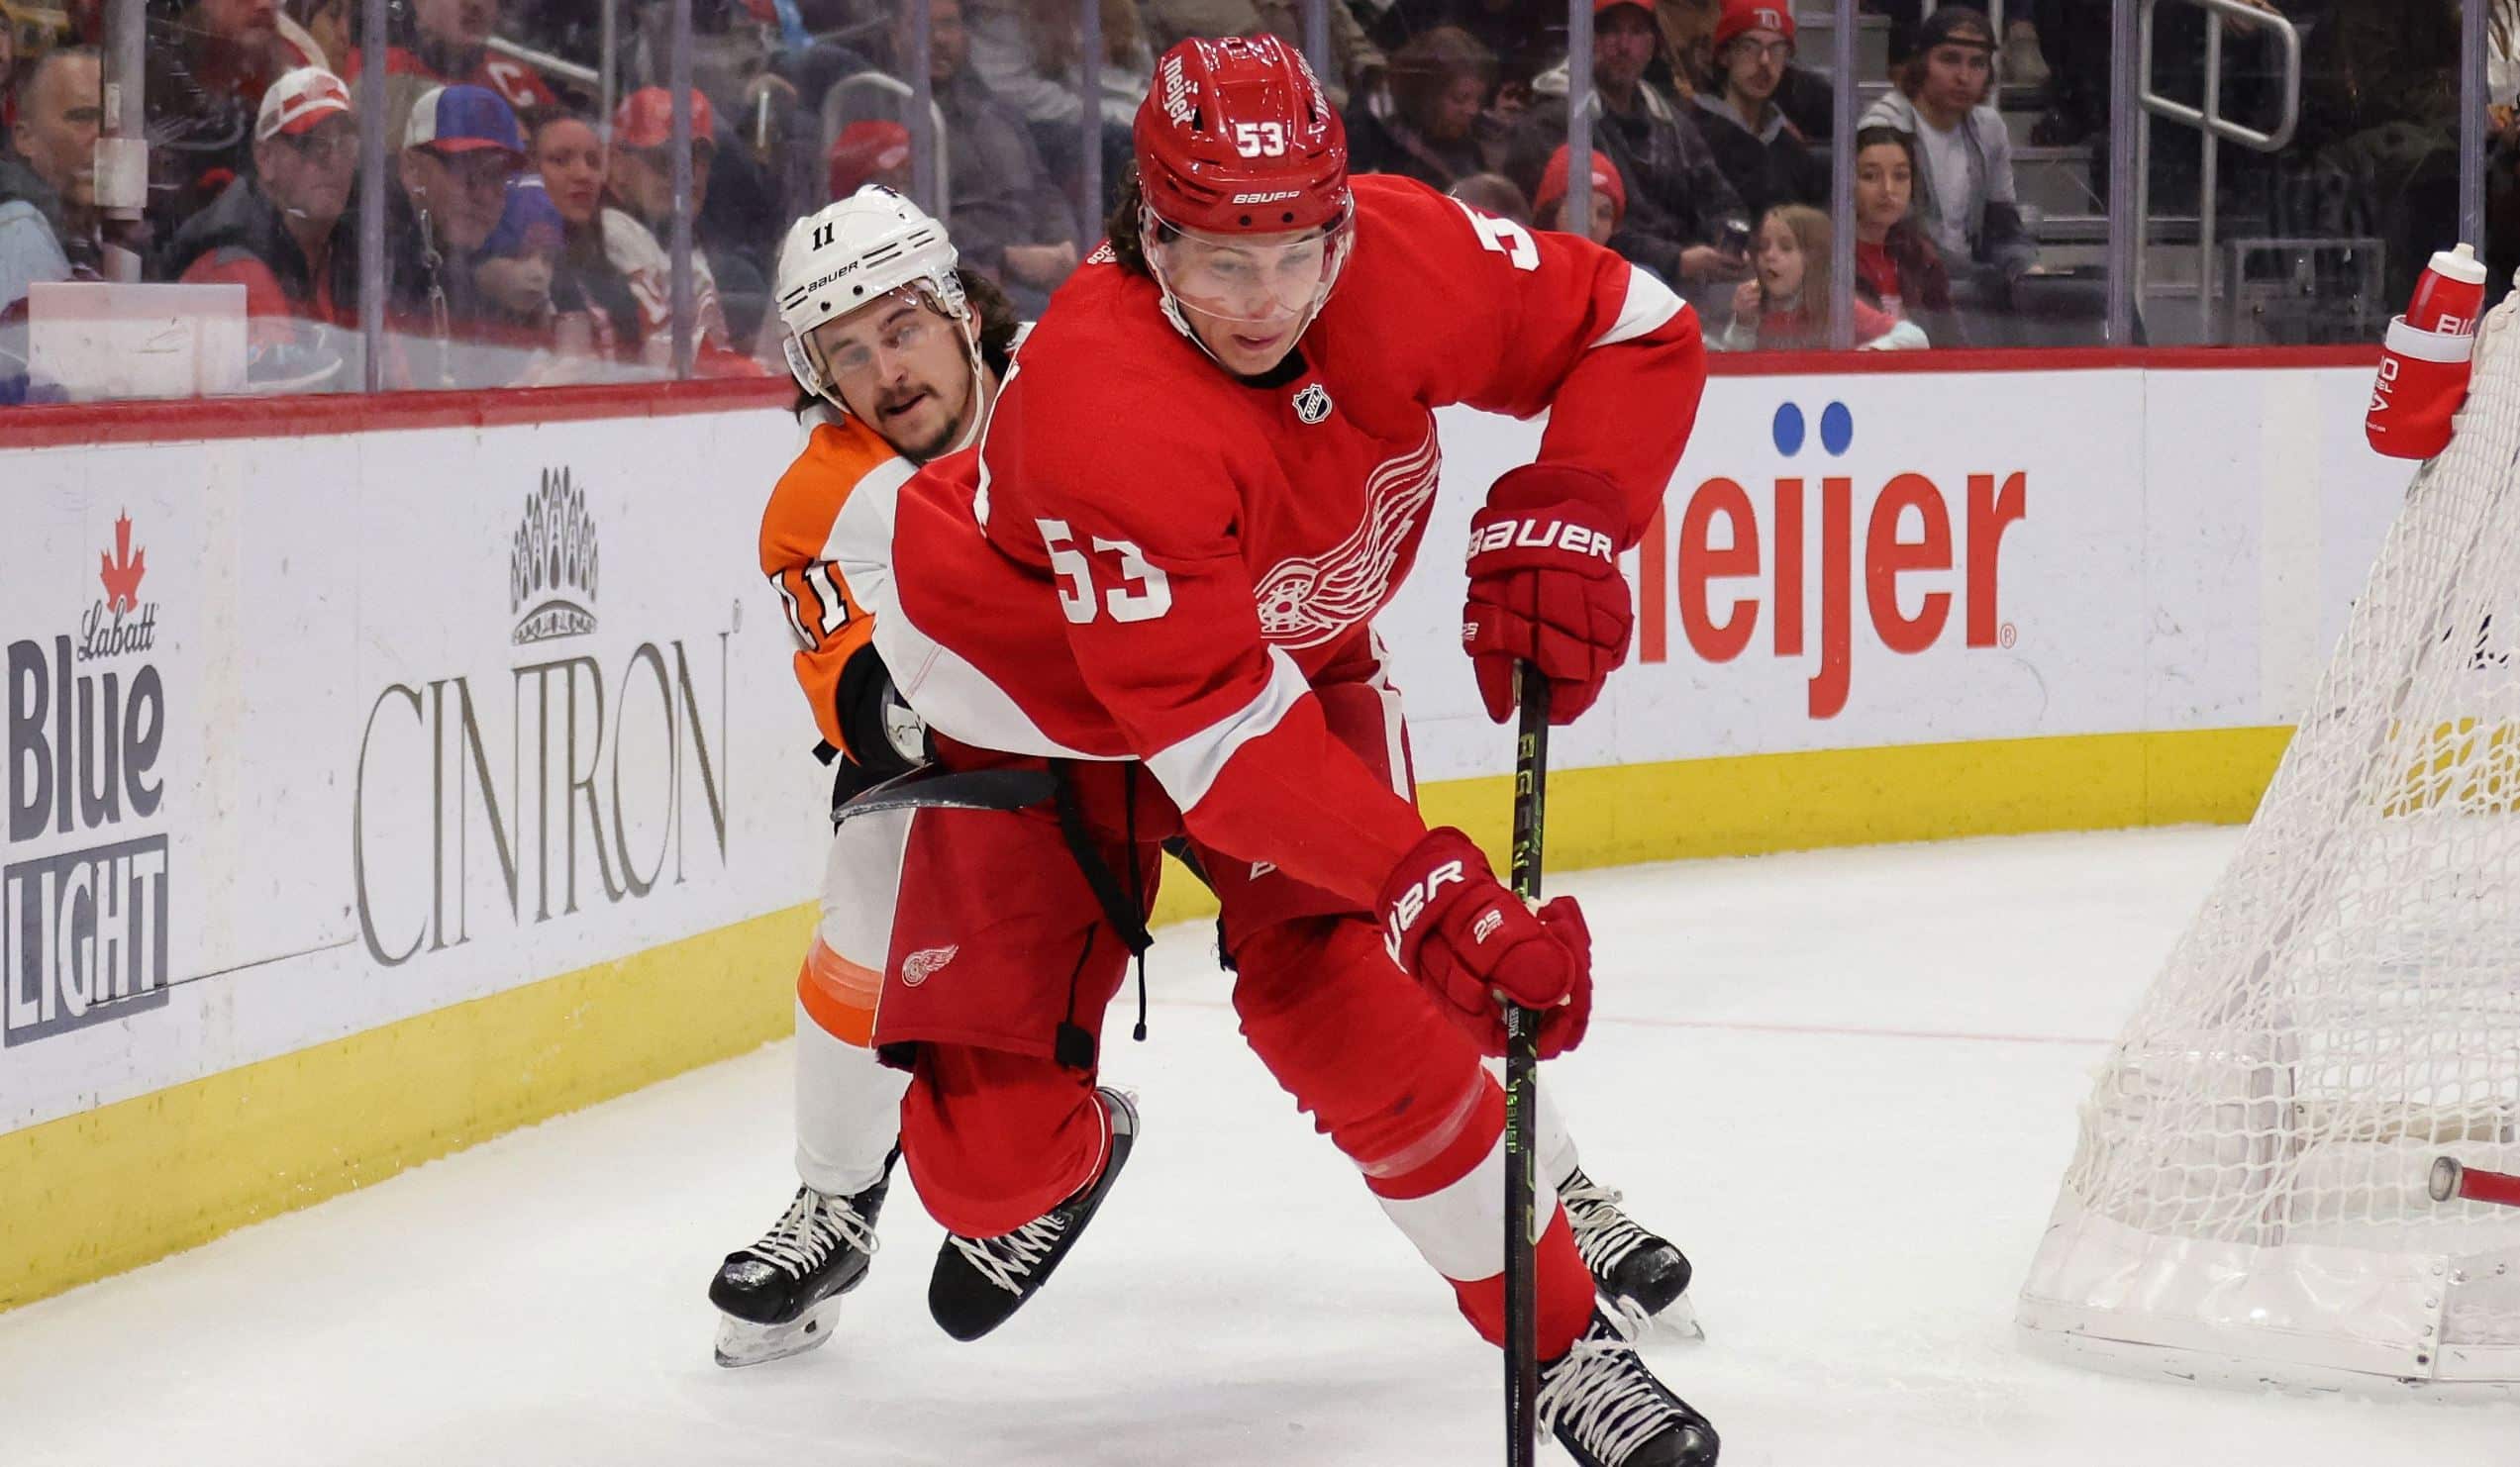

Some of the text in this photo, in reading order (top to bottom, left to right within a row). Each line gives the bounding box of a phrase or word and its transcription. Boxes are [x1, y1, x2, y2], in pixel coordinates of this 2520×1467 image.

[1163, 54, 1198, 129] meijer
[1235, 122, 1286, 158] 53
[812, 221, 835, 252] 11
[1035, 518, 1172, 624] 53
[1465, 519, 1613, 563] BAUER
[77, 596, 159, 662] Labatt
[770, 556, 851, 652] 11
[7, 635, 165, 842] Blue
[353, 631, 730, 968] CINTRON
[7, 848, 166, 1031] LIGHT
